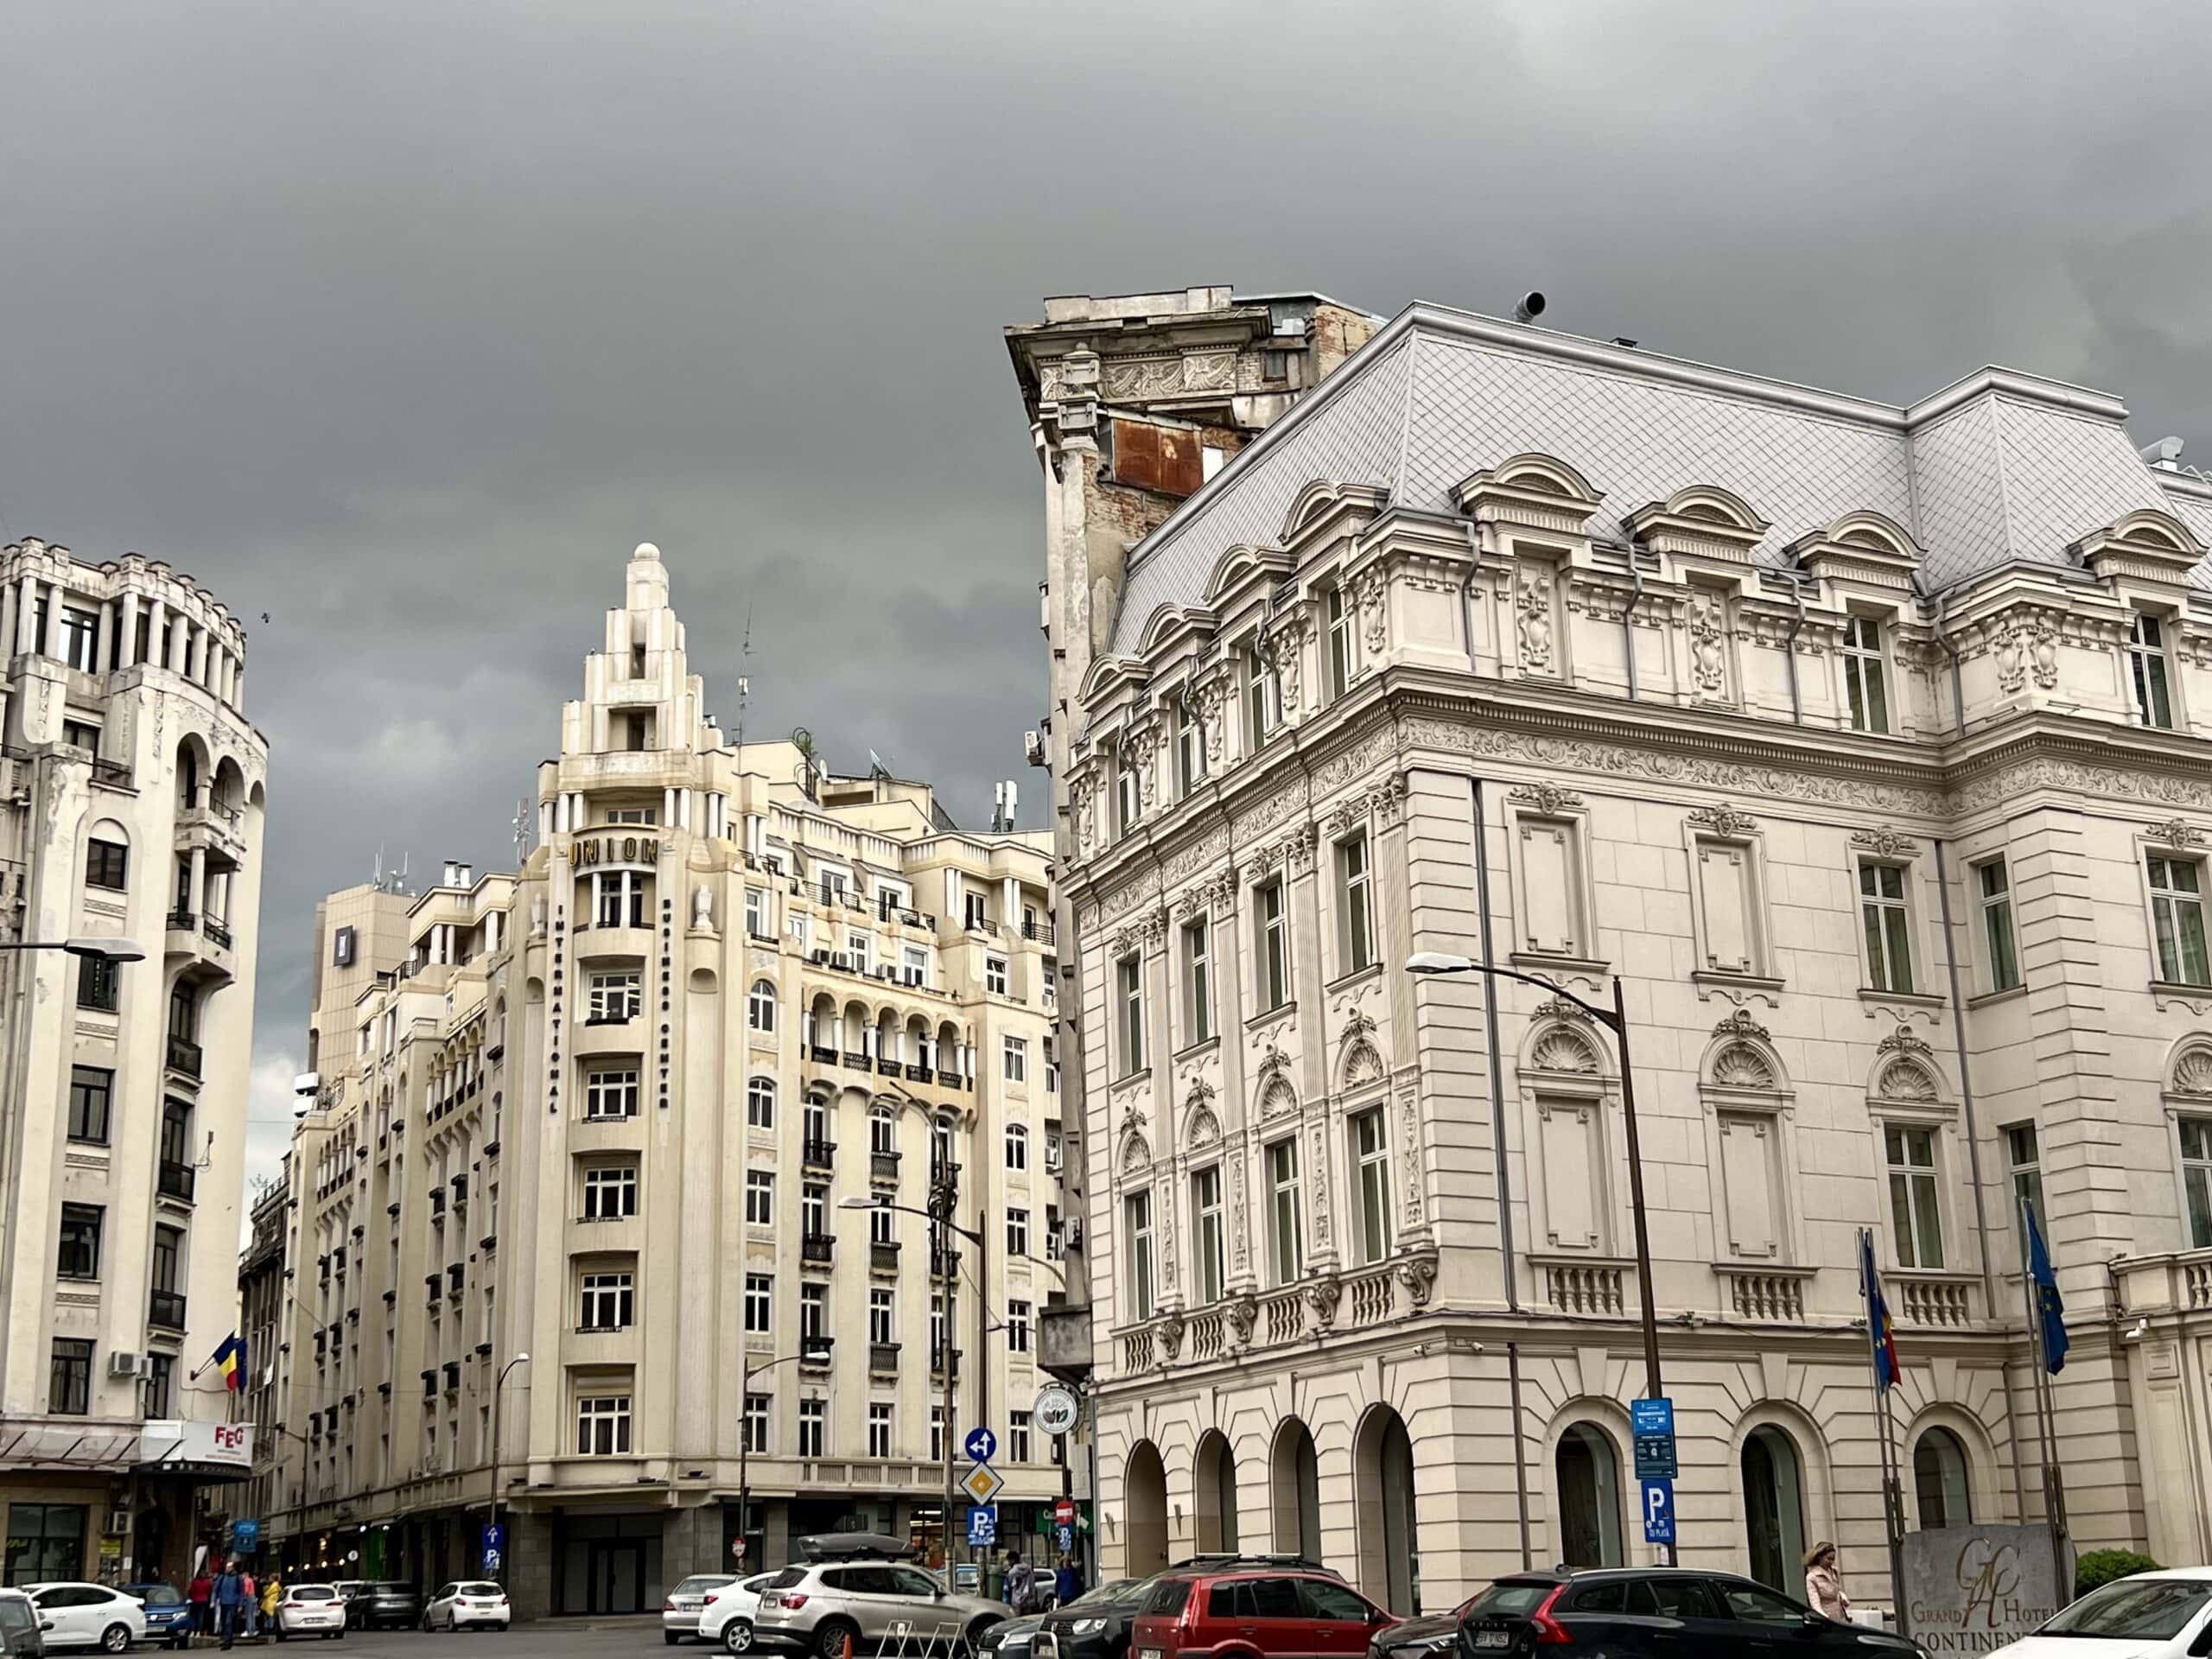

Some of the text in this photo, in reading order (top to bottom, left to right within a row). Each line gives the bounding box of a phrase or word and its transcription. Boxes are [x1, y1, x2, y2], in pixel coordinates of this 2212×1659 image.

[568, 836, 658, 867] UNION
[550, 904, 564, 1114] INTERNATIONAL
[659, 899, 671, 1109] BUSINESS CENTER
[215, 1426, 244, 1448] FEG
[1648, 1487, 1665, 1522] P
[974, 1512, 988, 1534] P
[1911, 1600, 1962, 1624] GRAND
[1914, 1630, 2032, 1653] CONTINEN
